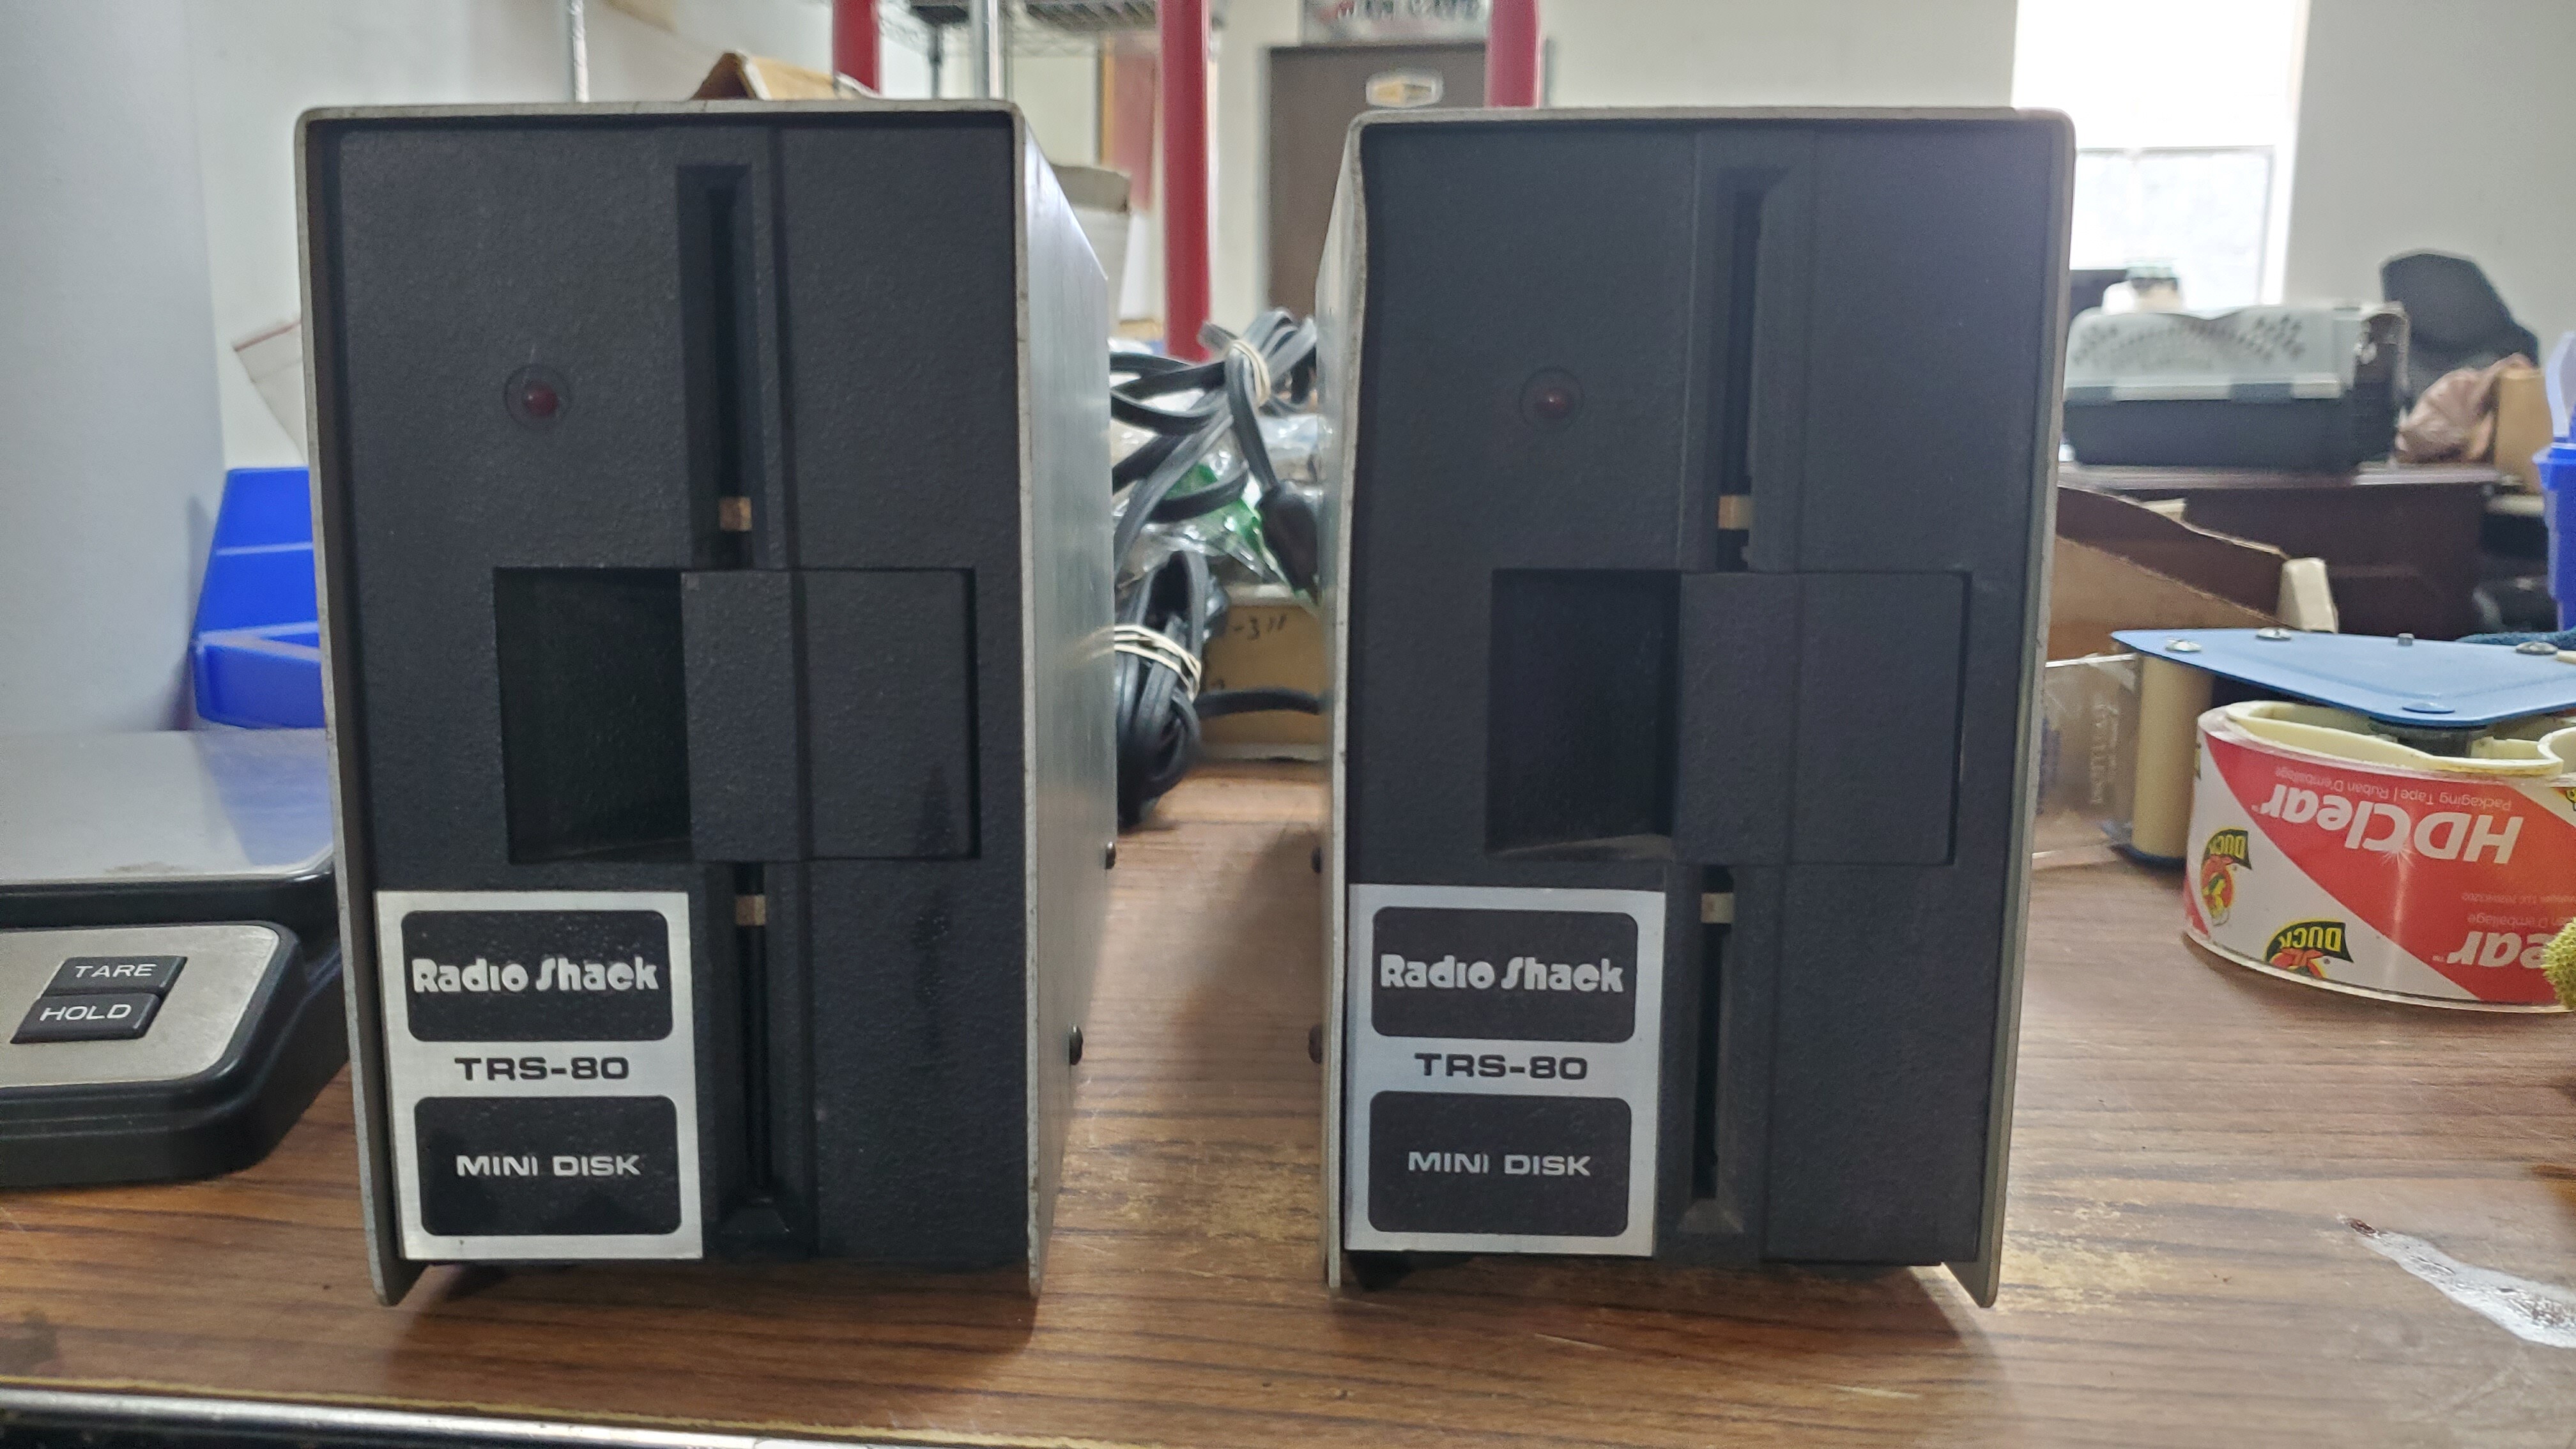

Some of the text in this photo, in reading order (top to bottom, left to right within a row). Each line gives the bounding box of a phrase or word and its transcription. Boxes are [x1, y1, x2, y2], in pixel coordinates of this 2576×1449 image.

[2347, 781, 2389, 799] Ruban
[2400, 788, 2434, 806] Tape
[2439, 792, 2512, 811] Packaging
[2278, 926, 2342, 953] DUCK
[2446, 931, 2557, 969] ear
[74, 963, 158, 979] TARE
[412, 956, 659, 993] Radio Shack
[1380, 954, 1624, 992] Radio Shack
[39, 1003, 132, 1022] HOLD
[454, 1056, 630, 1081] TRS-80
[1413, 1052, 1588, 1080] TRS-80
[456, 1154, 641, 1177] MINI DISK
[1408, 1151, 1592, 1177] MINI DISK
